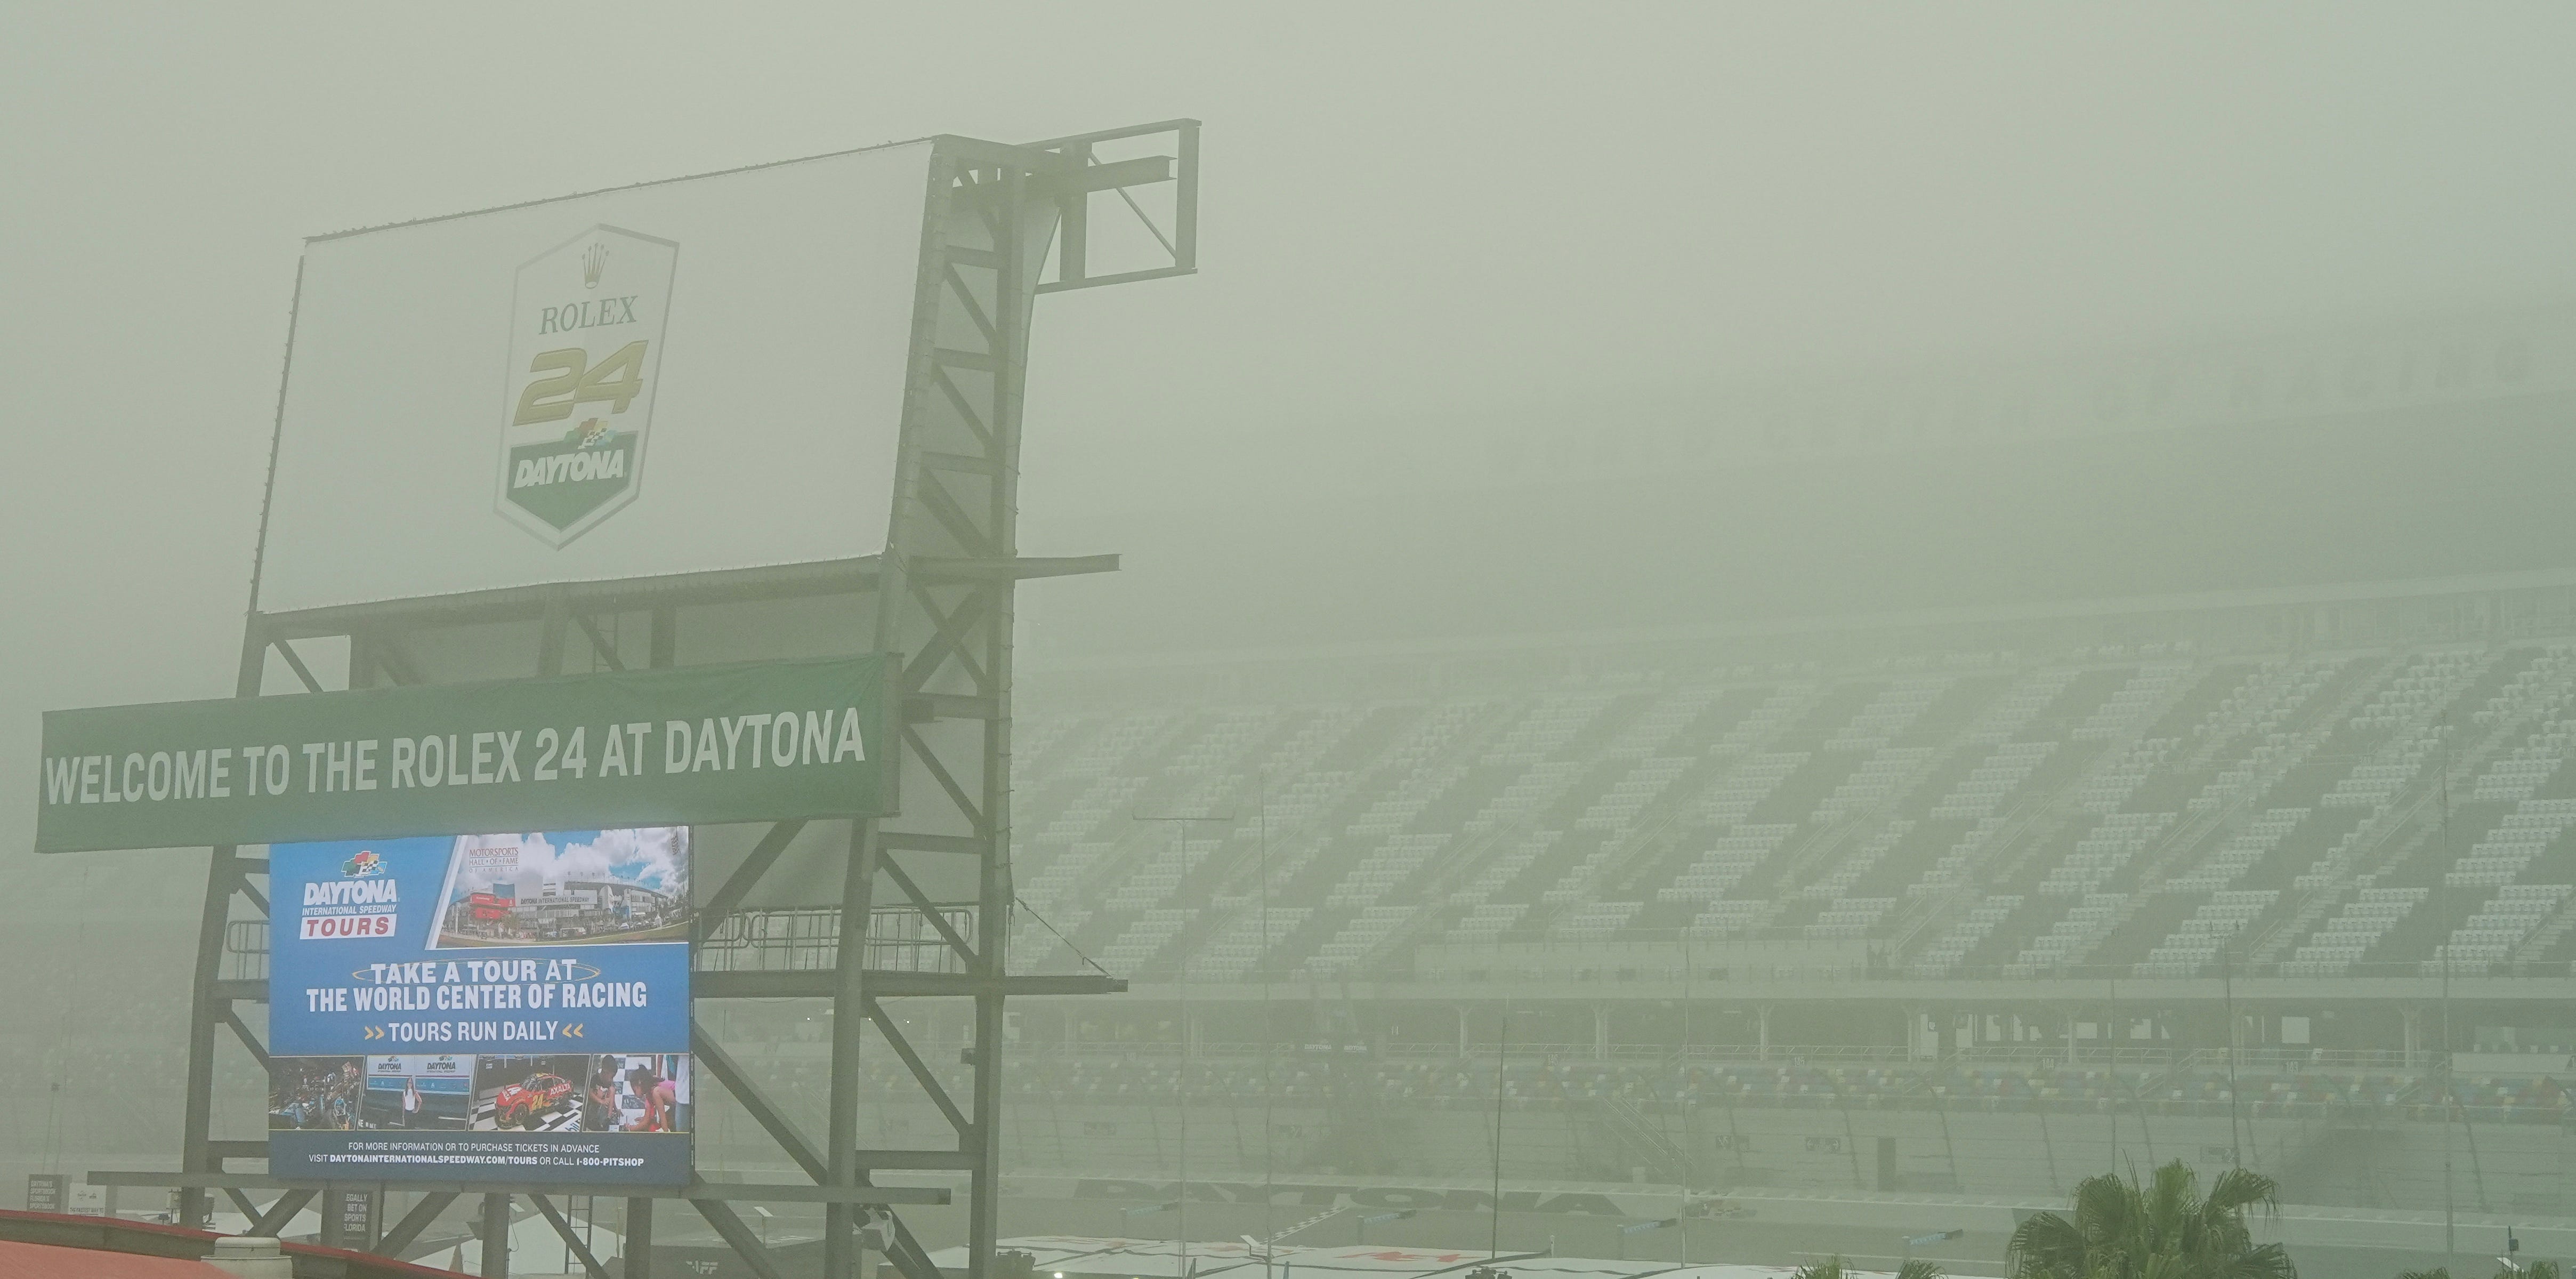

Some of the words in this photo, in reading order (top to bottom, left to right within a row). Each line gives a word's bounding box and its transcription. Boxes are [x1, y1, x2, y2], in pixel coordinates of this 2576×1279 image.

[539, 296, 638, 335] ROLEX
[513, 340, 649, 426] 24
[2090, 358, 2178, 422] OF
[2226, 335, 2532, 408] RACING
[514, 449, 625, 488] DAYTONA
[46, 749, 231, 805] WELCOME
[243, 745, 289, 796] TO
[303, 740, 377, 793] THE
[392, 731, 522, 789] ROLEX
[535, 727, 587, 781] 24
[599, 722, 651, 777] AT
[665, 707, 866, 774] DAYTONA
[469, 847, 519, 857] MOTORSPORTS
[303, 879, 398, 905] DAYTONA
[302, 906, 357, 916] INTERNATIONAL
[359, 904, 397, 913] SPEEDWAY
[306, 916, 389, 937] TOURS
[370, 962, 437, 984] TAKE
[443, 961, 461, 983] A
[467, 960, 537, 982] TOUR
[545, 959, 577, 981] AT
[306, 988, 347, 1012] THE
[353, 986, 430, 1011] WORLD
[437, 984, 521, 1010] CENTER
[528, 984, 556, 1008] OF
[562, 982, 647, 1008] RACING
[388, 1022, 452, 1042] TOURS
[458, 1021, 497, 1041] RUN
[503, 1020, 559, 1040] DAILY
[550, 1083, 571, 1096] AXALTA
[531, 1094, 544, 1110] 24
[348, 1142, 364, 1151] FOR
[390, 1143, 443, 1151] INFORMATION
[445, 1143, 456, 1151] OR
[471, 1143, 513, 1152] PURCHASE
[515, 1144, 548, 1152] TICKETS
[560, 1145, 600, 1153] ADVANCE
[329, 1154, 538, 1165] DAYTONAINTERNATIONALSPEEDWAY.COM/TOURS
[539, 1156, 551, 1165] OR
[553, 1157, 574, 1165] CALL
[577, 1157, 644, 1167] 1-800-PITSHOP
[1073, 1178, 1625, 1216] DAYTONA
[344, 1213, 366, 1222] SPORTS
